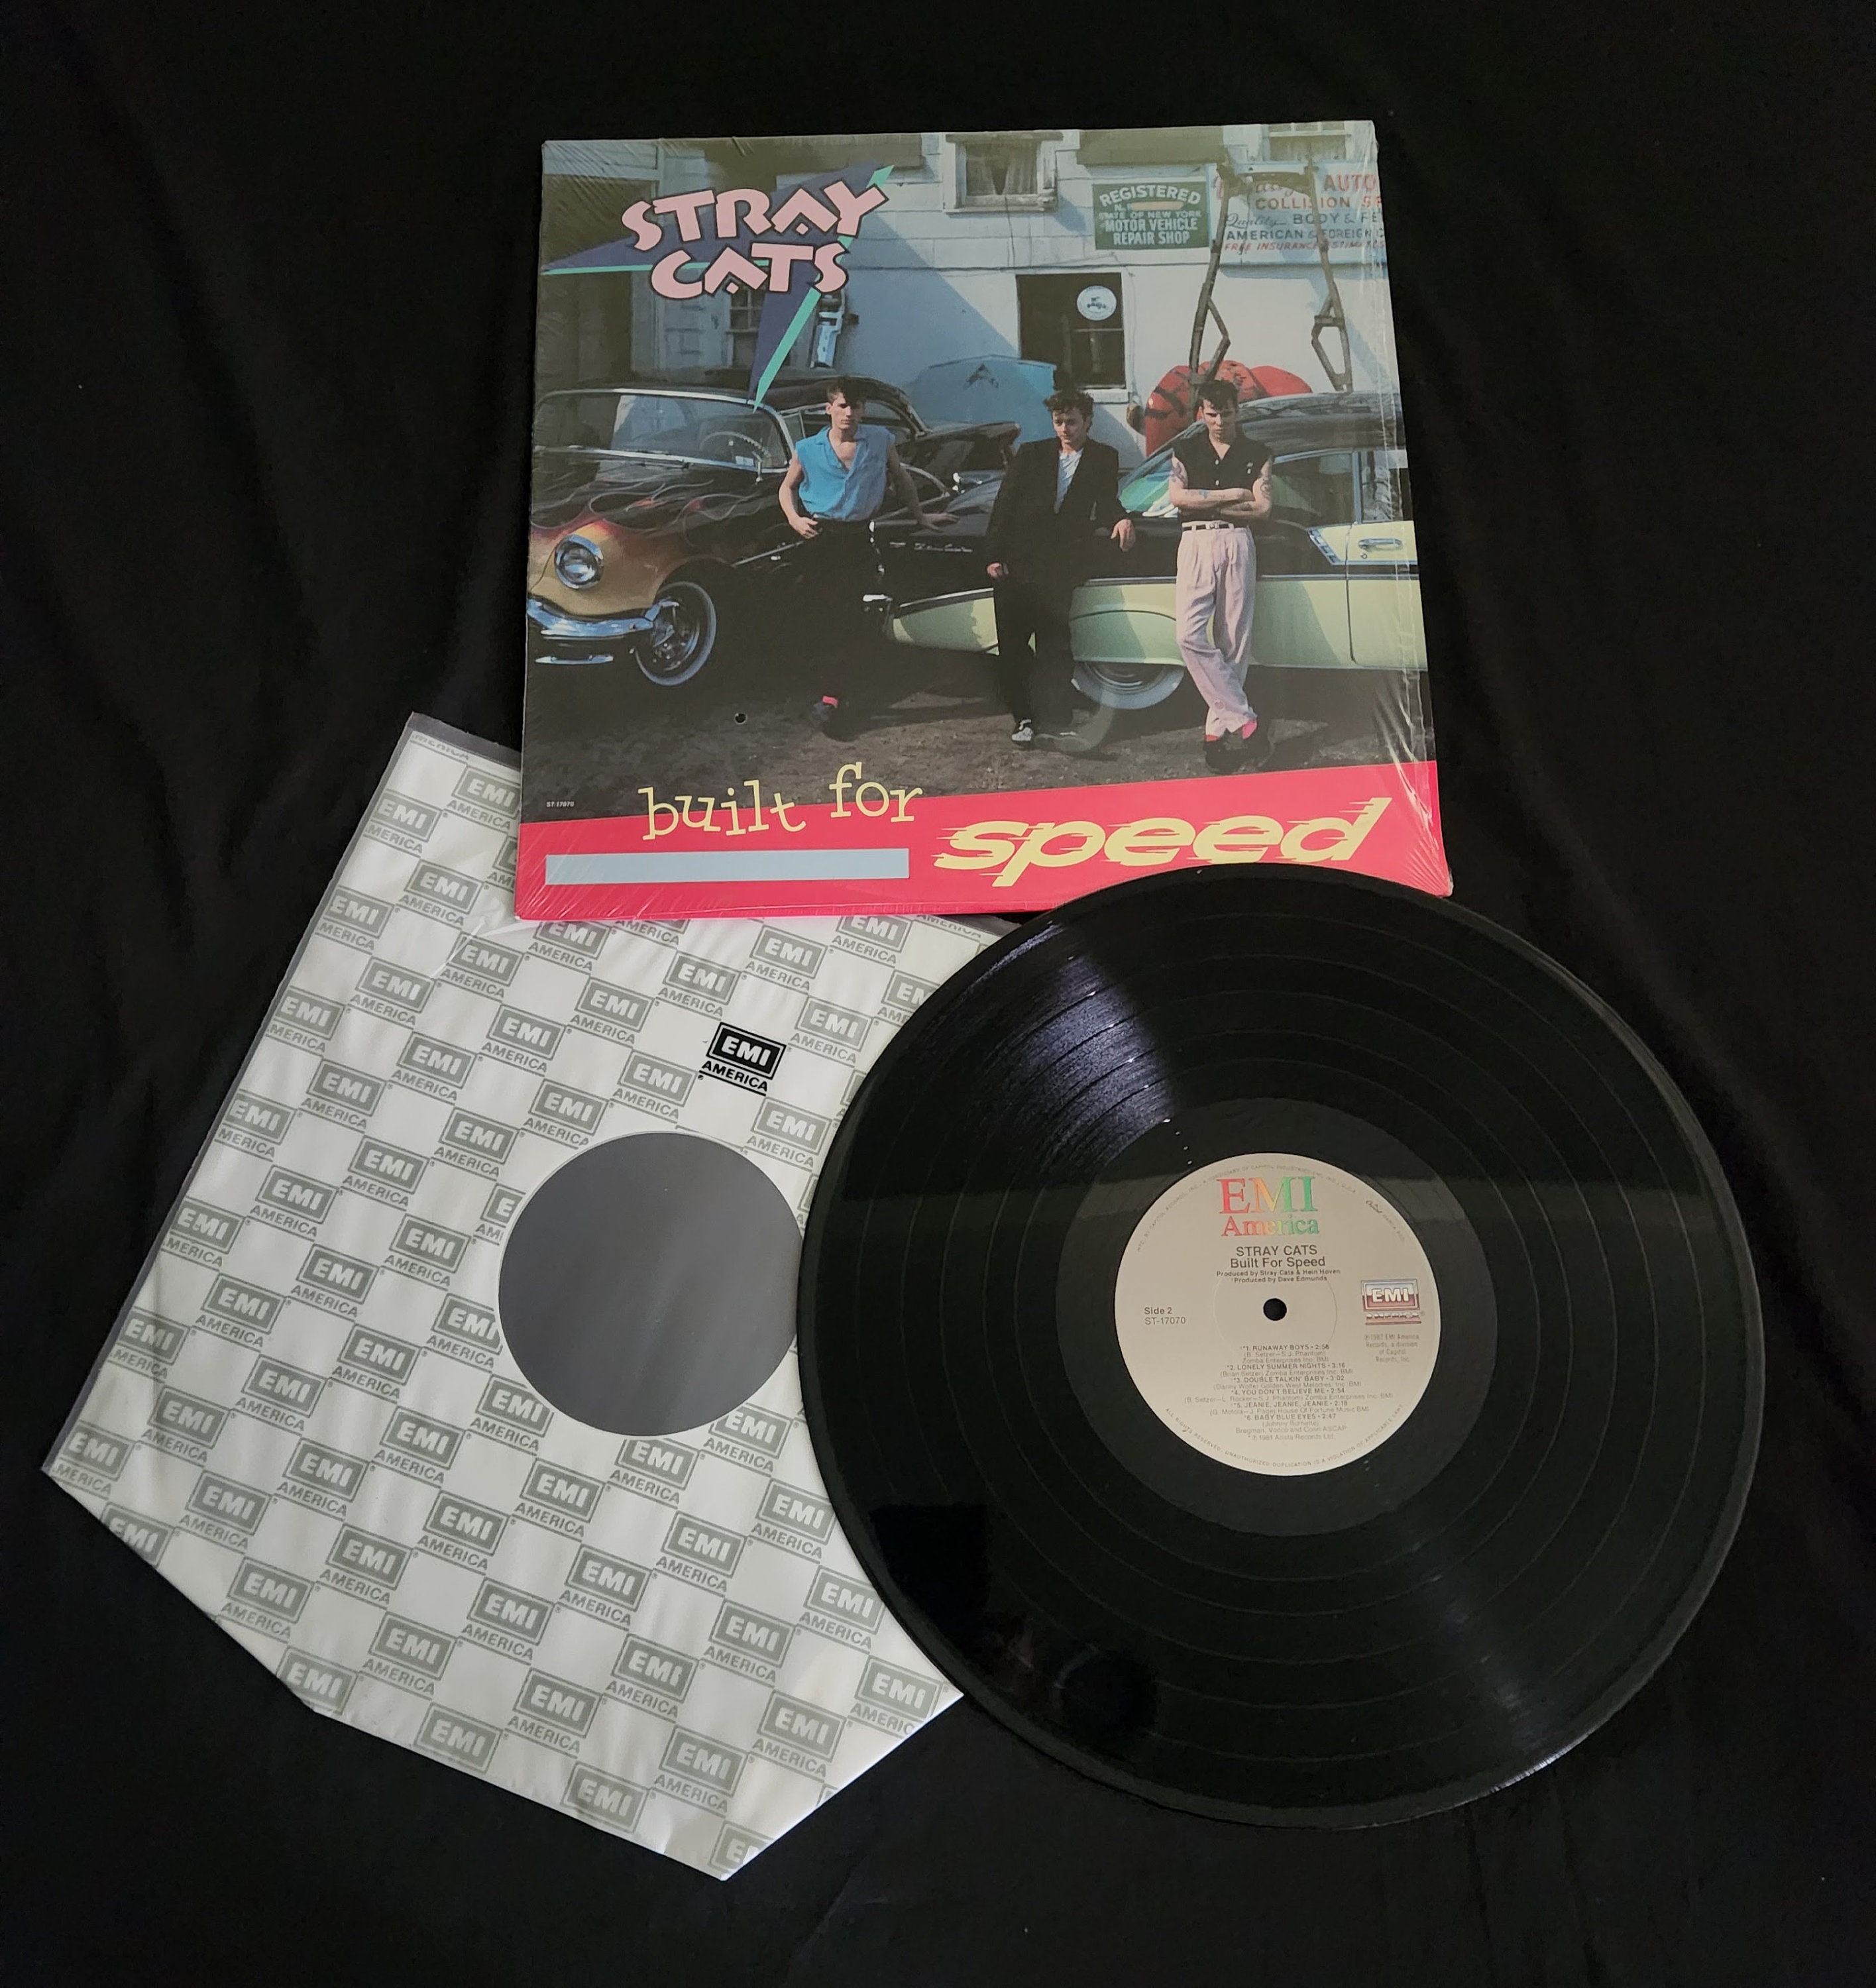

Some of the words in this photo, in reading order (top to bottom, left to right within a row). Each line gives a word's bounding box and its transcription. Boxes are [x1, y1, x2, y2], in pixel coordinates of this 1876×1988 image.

[1099, 184, 1201, 207] REGISTERED
[1323, 174, 1376, 192] AUTO
[621, 180, 889, 251] STRAY
[1105, 219, 1146, 233] MOTOR
[1148, 217, 1198, 231] VEHICLE
[1293, 212, 1340, 225] BODY
[1113, 232, 1156, 245] REPAIR
[1158, 231, 1190, 245] SHOP
[1224, 242, 1252, 251] FREE
[1226, 229, 1303, 241] AMERICAN
[651, 243, 848, 299] CATS
[467, 778, 516, 806] EMI
[446, 799, 512, 829] AMERICA
[638, 779, 806, 840] built
[828, 760, 924, 824] for
[933, 796, 1393, 888] speed
[419, 871, 472, 902] EMI
[399, 894, 466, 925] AMERICA
[460, 944, 510, 975] EMI
[371, 969, 422, 1001] EMI
[440, 968, 505, 998] AMERICA
[677, 962, 728, 993] EMI
[350, 993, 417, 1026] AMERICA
[658, 987, 724, 1017] AMERICA
[809, 1007, 859, 1039] EMI
[722, 1033, 773, 1066] EMI
[790, 1032, 857, 1064] AMERICA
[321, 1072, 372, 1104] EMI
[631, 1060, 682, 1094] EMI
[701, 1060, 768, 1092] AMERICA
[302, 1097, 368, 1130] AMERICA
[612, 1087, 680, 1120] AMERICA
[455, 1120, 504, 1152] EMI
[766, 1109, 816, 1142] EMI
[433, 1146, 500, 1178] AMERICA
[747, 1135, 814, 1169] AMERICA
[271, 1178, 323, 1211] EMI
[1217, 1176, 1319, 1214] EMI
[250, 1204, 318, 1238] AMERICA
[1220, 1213, 1320, 1237] America
[1230, 1257, 1259, 1269] Built
[1262, 1257, 1282, 1268] For
[1286, 1256, 1326, 1270] Speed
[1235, 1246, 1279, 1257] STRAY
[1283, 1244, 1317, 1256] CATS
[218, 1287, 270, 1321] EMI
[1372, 1288, 1409, 1302] EMI
[195, 1314, 264, 1348] AMERICA
[1144, 1316, 1186, 1325] ST-17070
[354, 1337, 406, 1371] EMI
[258, 1369, 310, 1403] EMI
[332, 1364, 400, 1400] AMERICA
[236, 1396, 305, 1431] AMERICA
[300, 1453, 351, 1486] EMI
[632, 1440, 685, 1475] EMI
[277, 1480, 347, 1517] AMERICA
[610, 1469, 680, 1504] AMERICA
[202, 1486, 256, 1521] EMI
[773, 1494, 825, 1529] EMI
[179, 1514, 248, 1550] AMERICA
[440, 1505, 490, 1541] EMI
[417, 1535, 488, 1571] AMERICA
[751, 1523, 822, 1559] AMERICA
[821, 1582, 874, 1618] EMI
[388, 1628, 440, 1665] EMI
[726, 1617, 779, 1653] EMI
[800, 1612, 872, 1650] AMERICA
[362, 1658, 435, 1696] AMERICA
[703, 1646, 777, 1683] AMERICA
[531, 1685, 585, 1721] EMI
[509, 1716, 580, 1754] AMERICA
[775, 1709, 829, 1745] EMI
[677, 1744, 730, 1779] EMI
[753, 1739, 827, 1777] AMERICA
[655, 1775, 728, 1813] AMERICA
